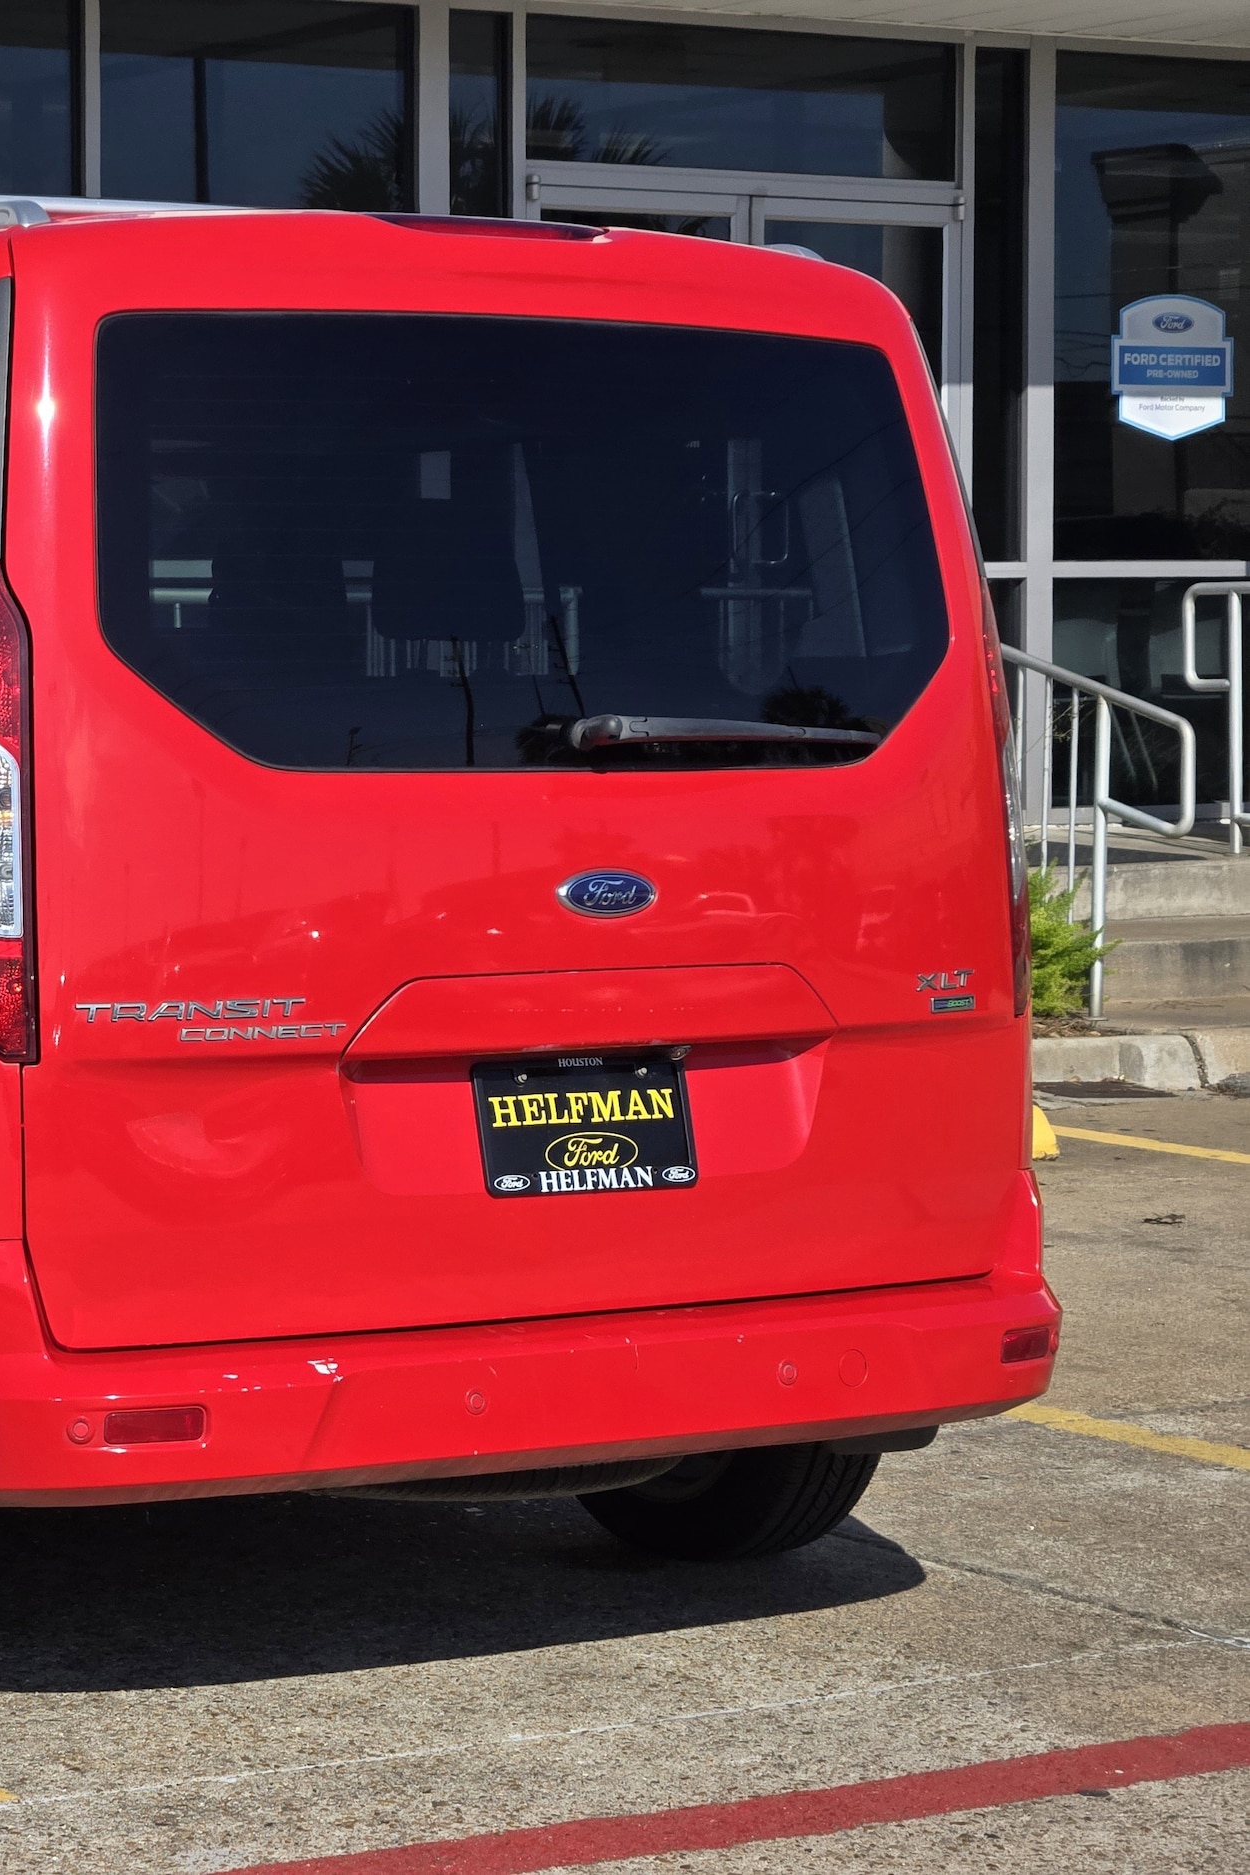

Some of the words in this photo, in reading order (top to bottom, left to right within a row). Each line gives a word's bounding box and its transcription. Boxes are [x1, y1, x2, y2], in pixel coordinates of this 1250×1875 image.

[1160, 315, 1186, 330] Ford
[1123, 353, 1157, 366] FORD
[1159, 354, 1221, 367] CERTIFIED
[1146, 369, 1199, 379] PRE-OWNED
[1138, 403, 1154, 411] Ford
[1155, 403, 1174, 411] Motor
[1175, 404, 1206, 412] Company
[583, 879, 637, 906] Ford
[916, 969, 975, 991] XLT
[75, 997, 306, 1022] TRANSIT
[180, 1023, 347, 1041] CONNECT
[558, 1057, 603, 1067] HOUSTON
[488, 1088, 675, 1128] HELFMAN
[563, 1137, 620, 1167] Ford
[539, 1166, 654, 1192] HELFMAN
[667, 1168, 690, 1181] Ford
[501, 1176, 525, 1190] Ford
